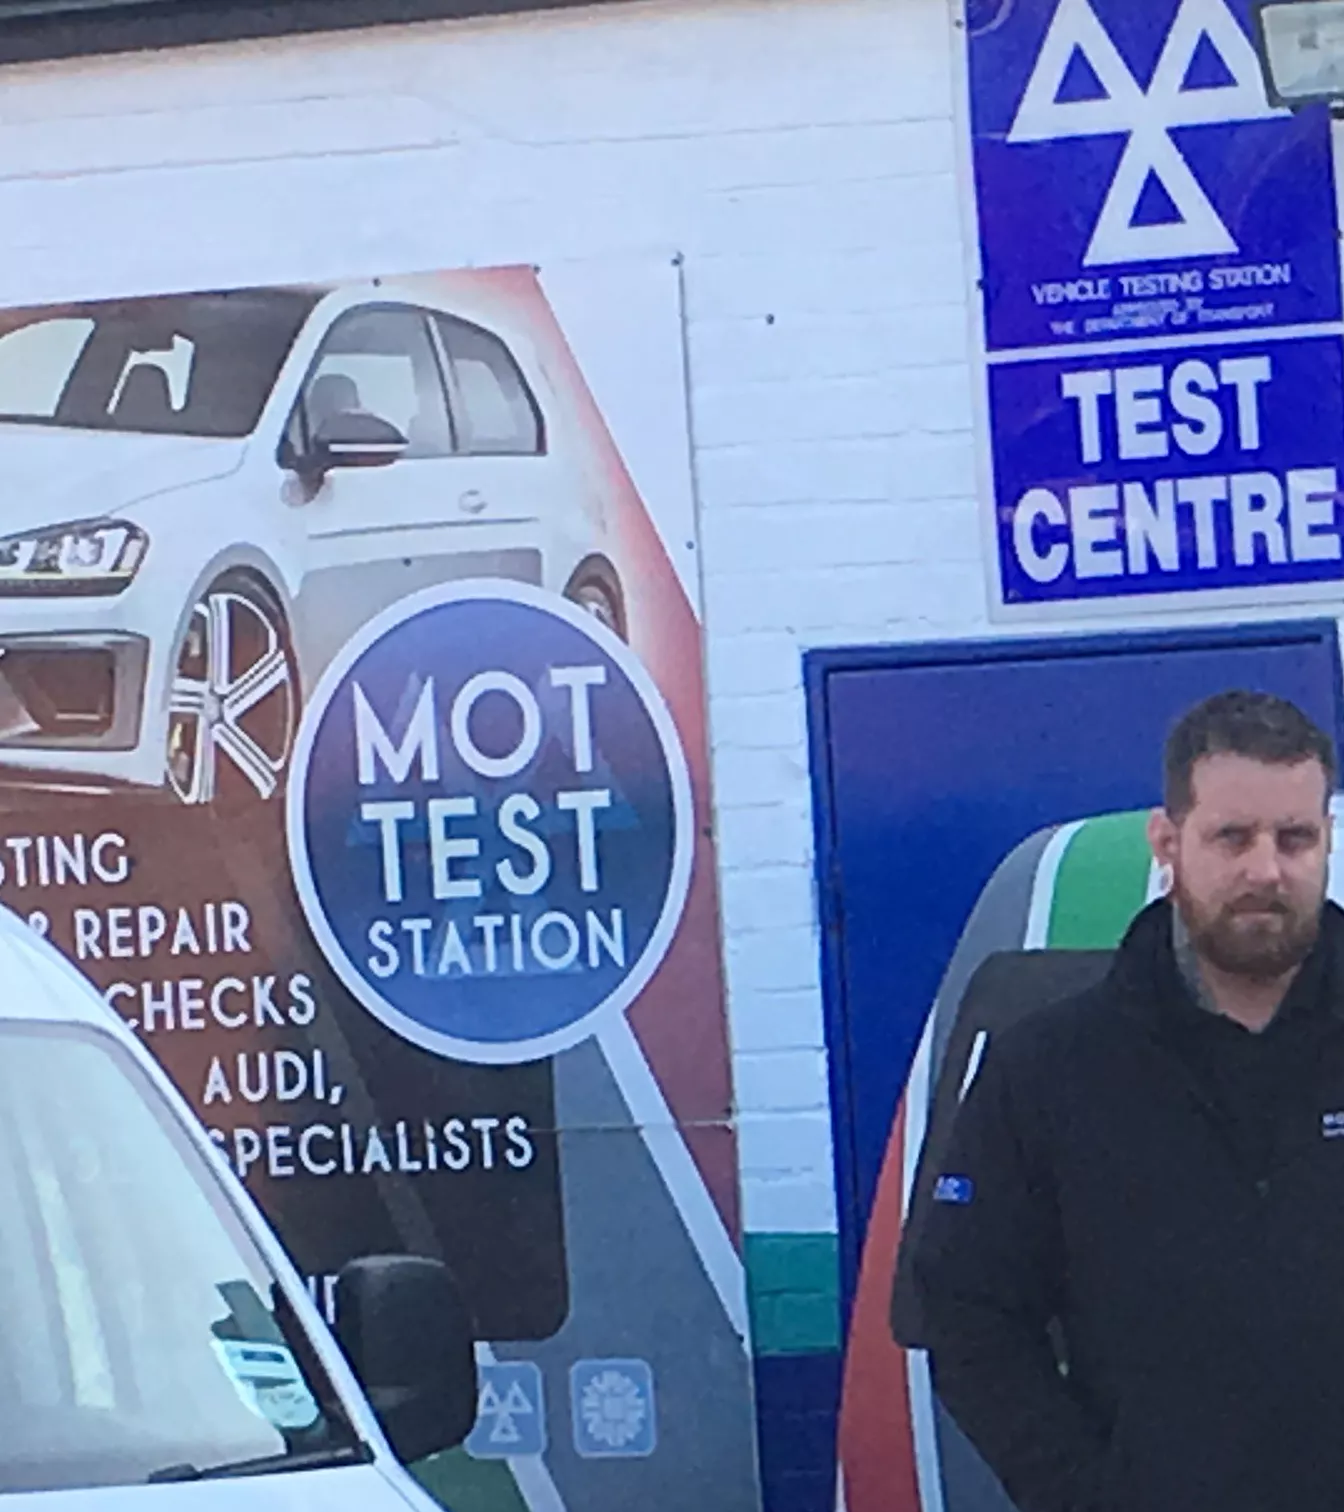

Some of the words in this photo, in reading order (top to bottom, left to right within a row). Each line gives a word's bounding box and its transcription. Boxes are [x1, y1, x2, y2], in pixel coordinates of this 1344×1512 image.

[1119, 269, 1203, 296] TESTING
[1208, 263, 1291, 290] STATION
[1061, 356, 1271, 464] TEST
[1012, 466, 1343, 584] CENTRE
[352, 666, 606, 785] MOT
[361, 789, 610, 902] TEST
[74, 901, 252, 960] REPAIR
[368, 908, 625, 978] STATION
[102, 971, 315, 1032] CHECKS
[203, 1049, 344, 1106] AUDI,
